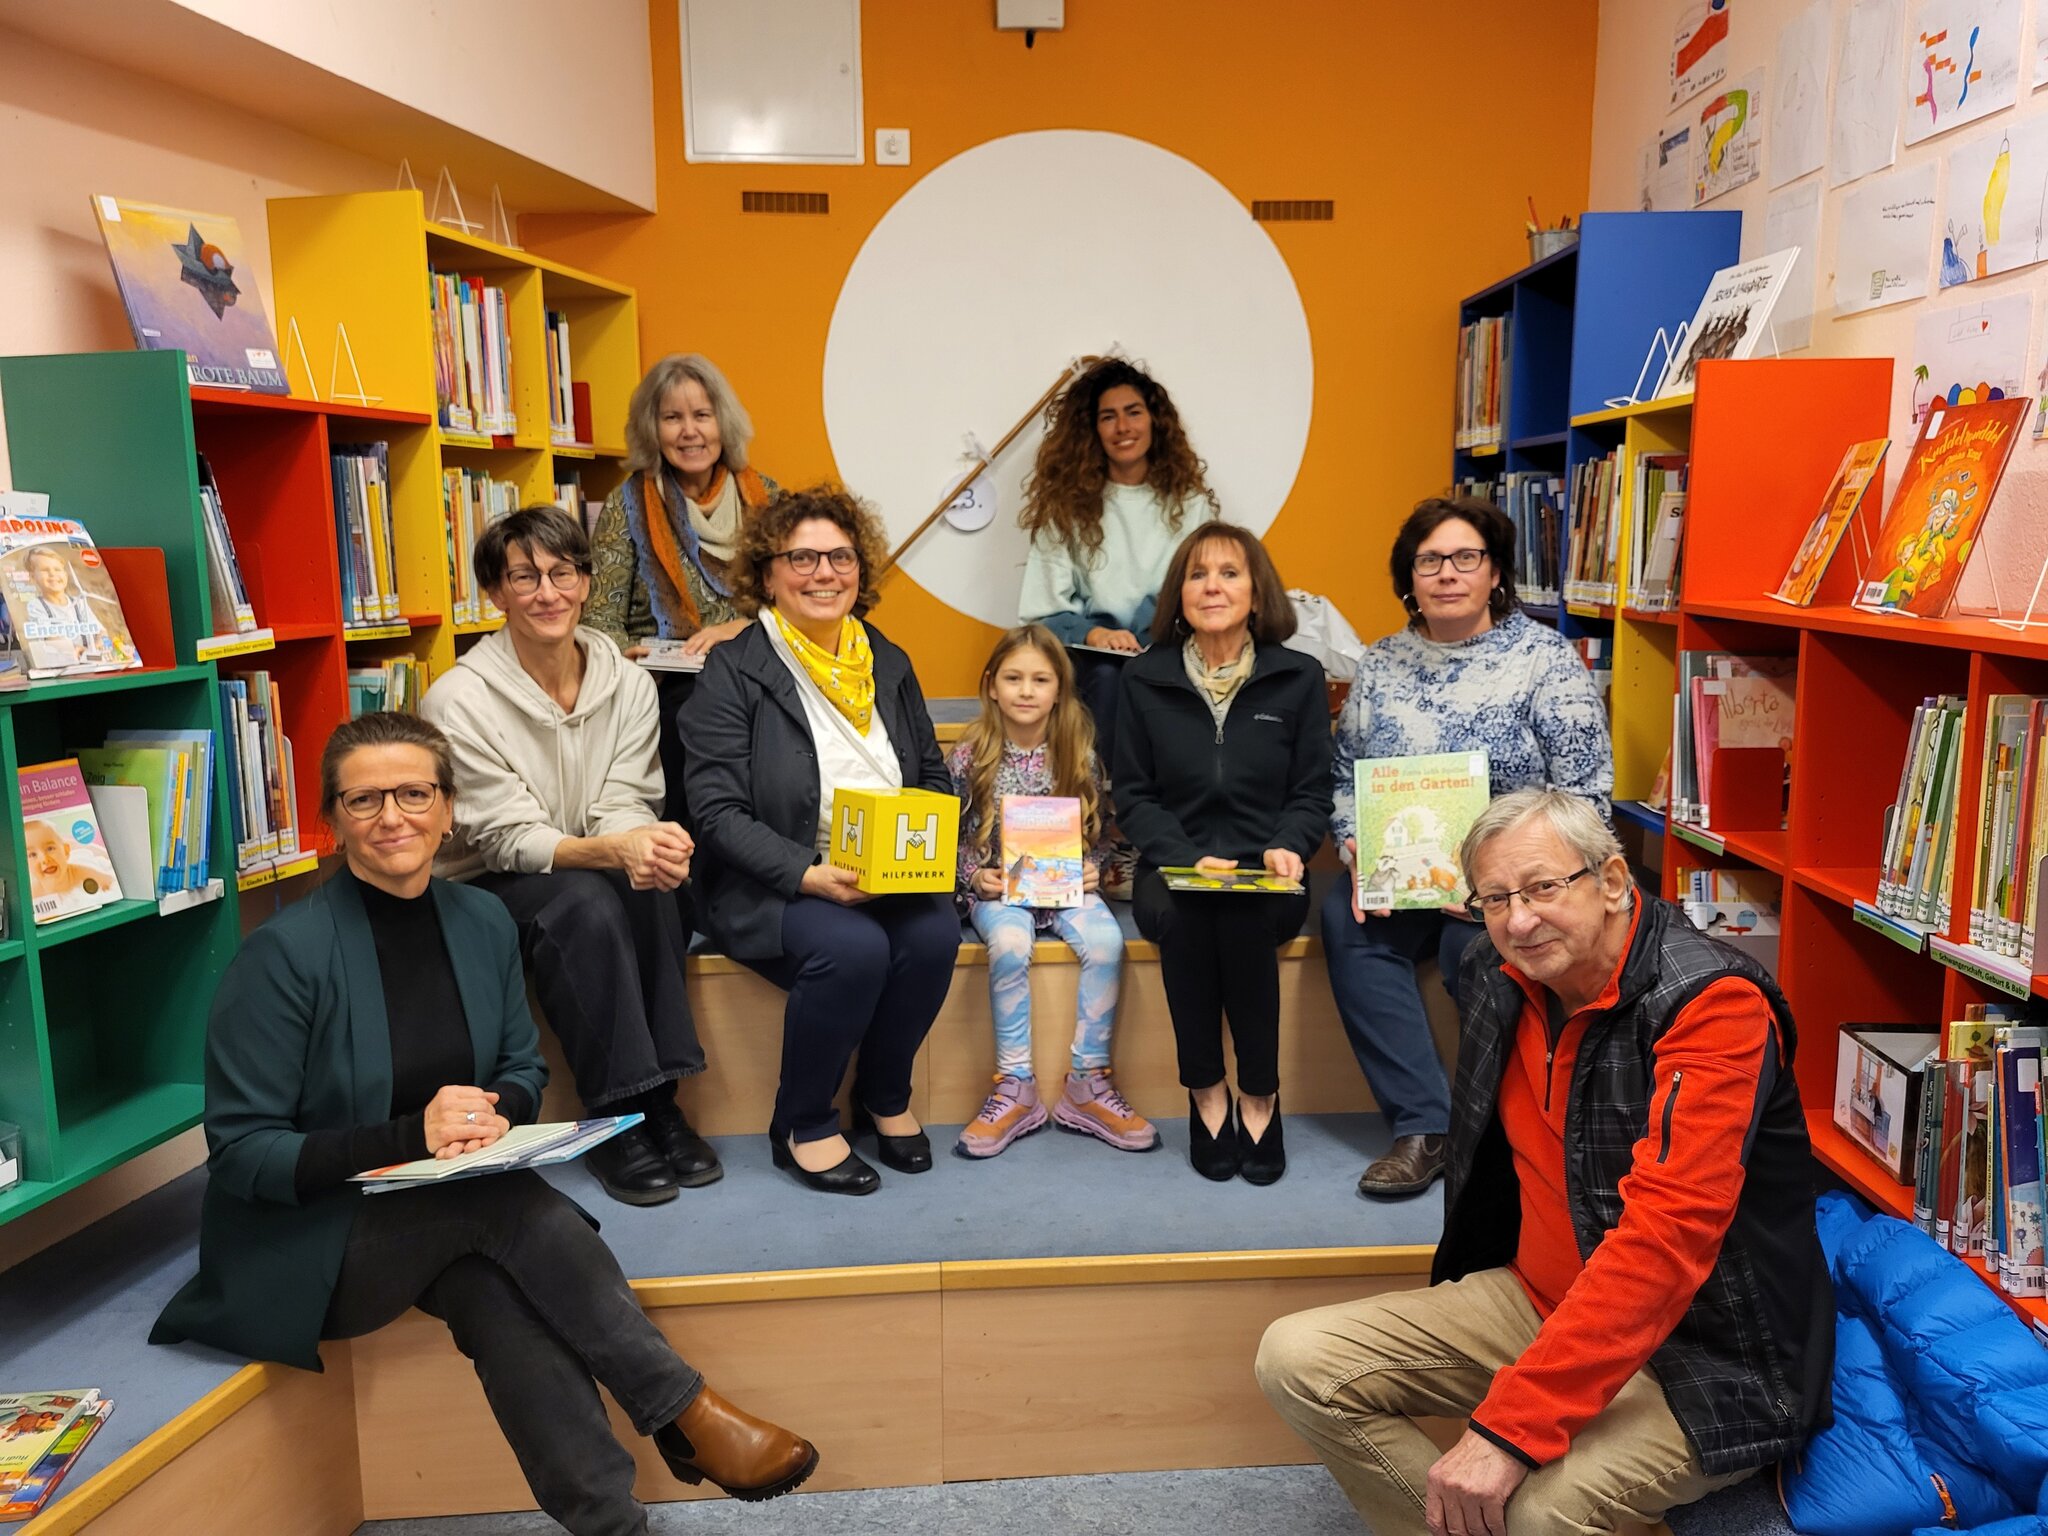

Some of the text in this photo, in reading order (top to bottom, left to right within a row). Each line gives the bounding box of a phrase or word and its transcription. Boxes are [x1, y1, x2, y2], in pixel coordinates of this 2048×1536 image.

[192, 365, 283, 387] ROTE BAUM
[25, 621, 99, 638] Energien
[1372, 766, 1399, 778] Alle
[31, 775, 78, 793] Balance
[1372, 776, 1474, 793] in den Garten!
[834, 860, 866, 877] HILFSWERK
[882, 871, 945, 879] HILFSWERK
[1985, 971, 2005, 987] Geburt
[2005, 981, 2011, 990] &
[2011, 983, 2027, 998] Baby
